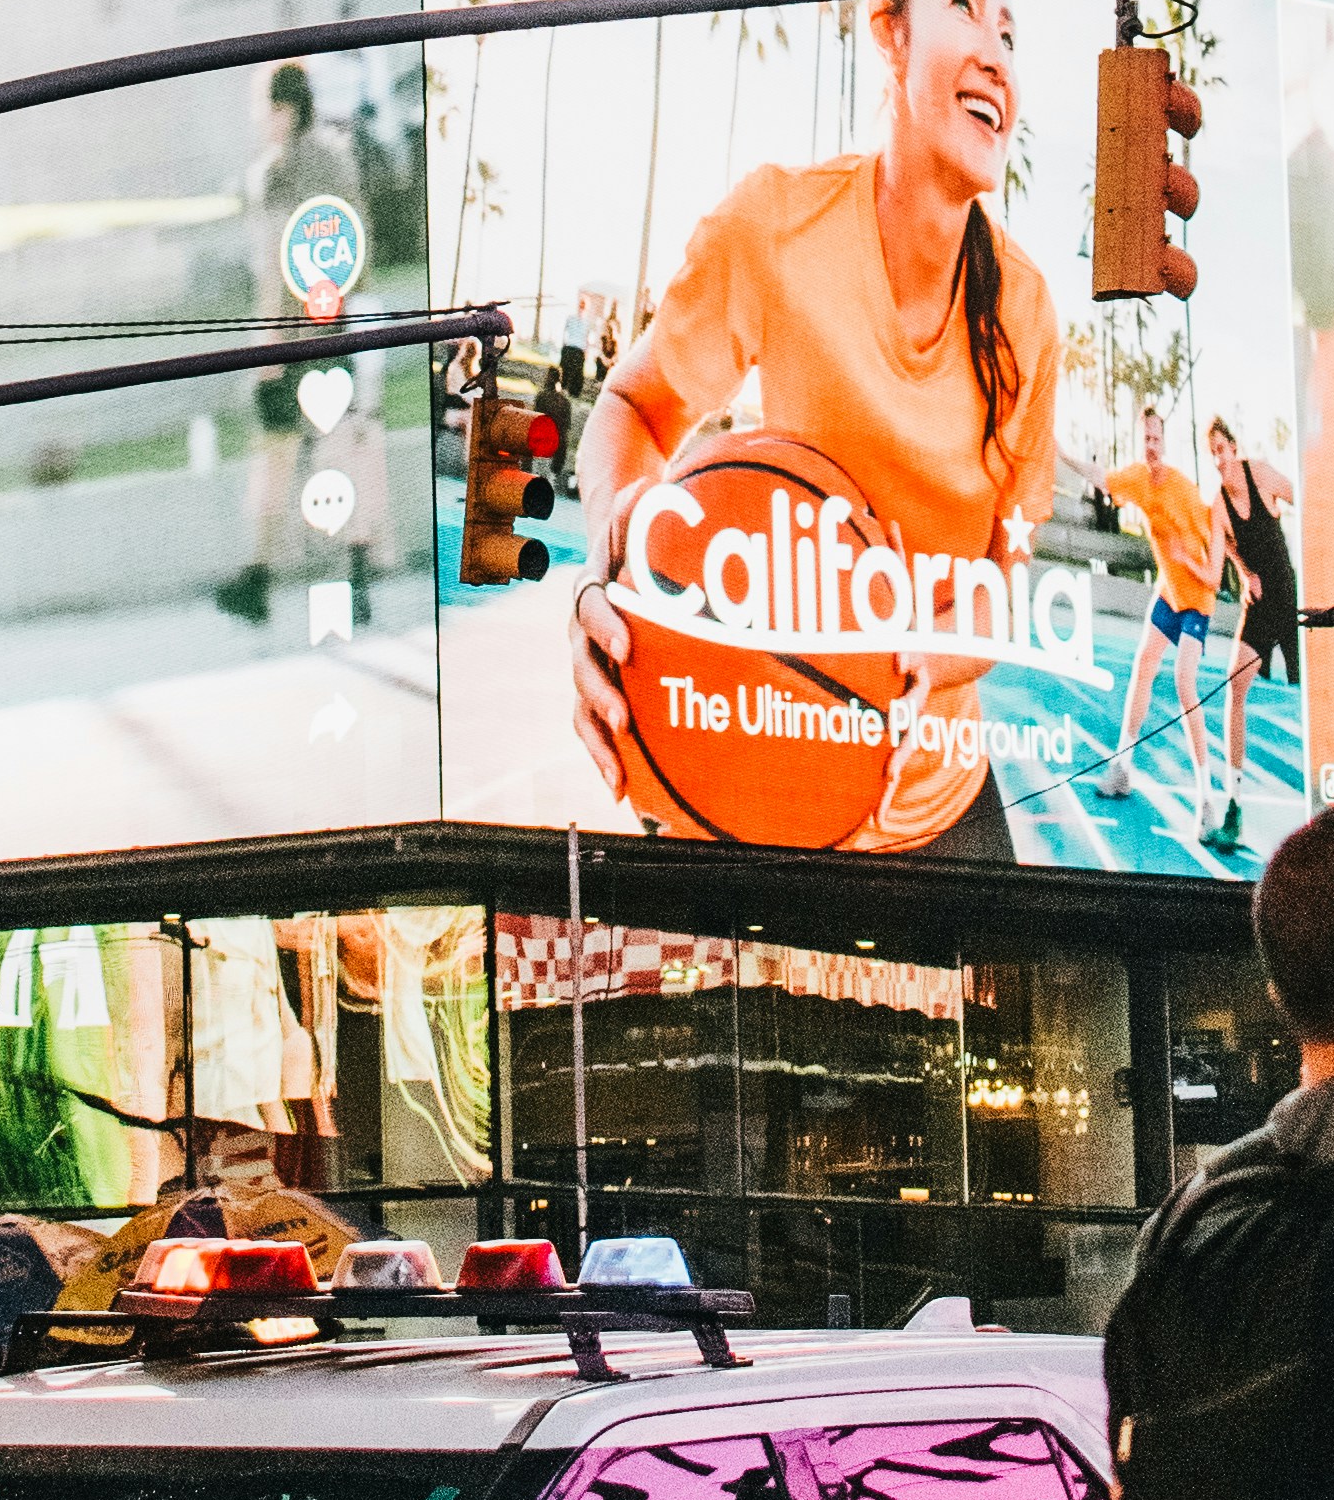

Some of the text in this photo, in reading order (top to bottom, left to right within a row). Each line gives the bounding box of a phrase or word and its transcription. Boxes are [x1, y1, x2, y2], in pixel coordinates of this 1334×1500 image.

[303, 212, 342, 239] visit
[312, 236, 354, 269] CA
[627, 482, 1096, 669] California
[660, 675, 1073, 769] The Ultimate Playground
